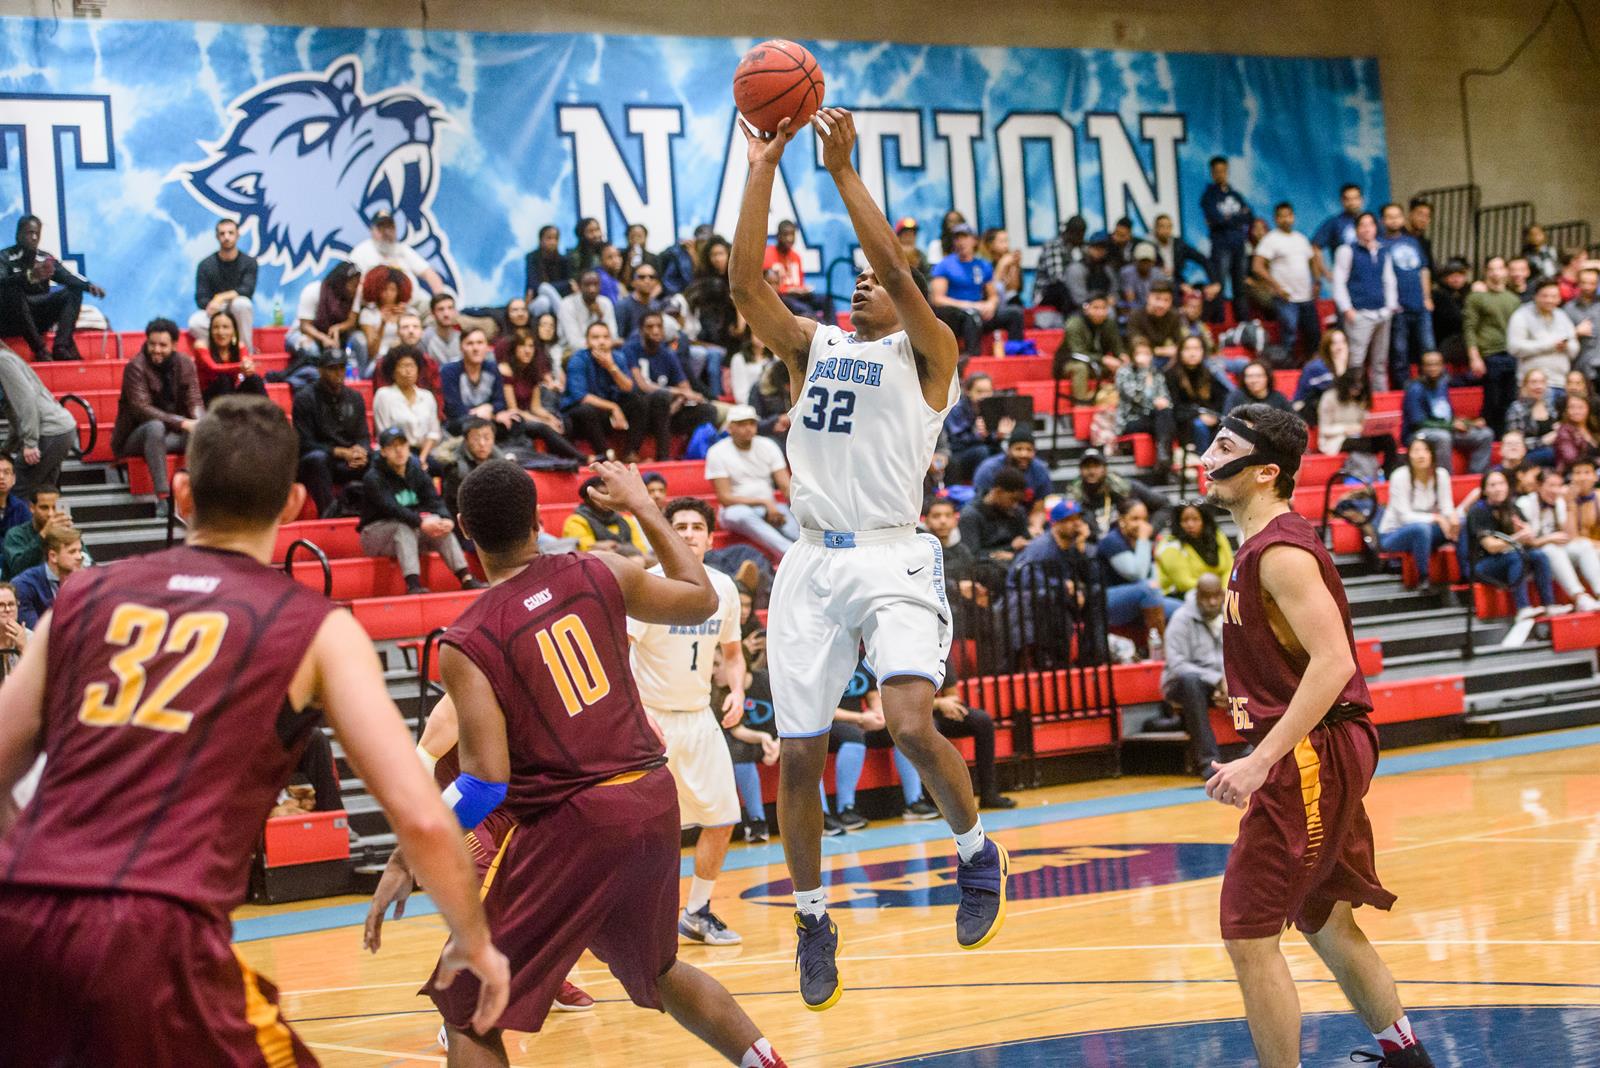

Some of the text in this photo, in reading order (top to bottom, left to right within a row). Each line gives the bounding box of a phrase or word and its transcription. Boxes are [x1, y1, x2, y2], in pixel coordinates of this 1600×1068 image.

[556, 103, 1187, 273] NATION
[803, 386, 856, 434] 32
[78, 603, 229, 734] 32
[535, 613, 610, 718] 10
[690, 641, 699, 672] 1
